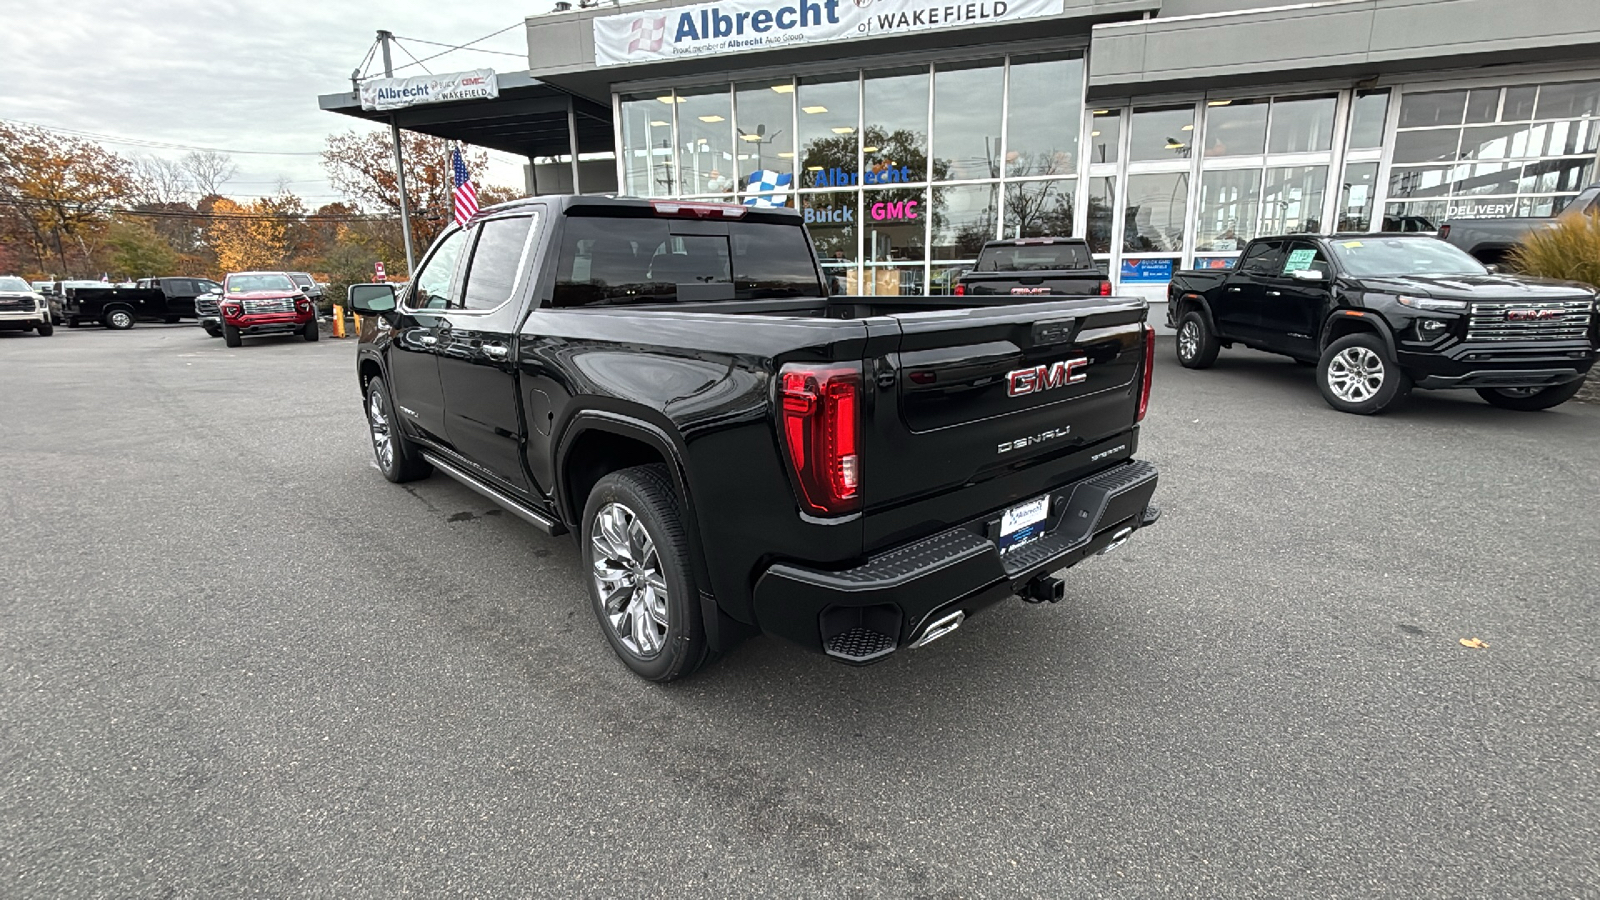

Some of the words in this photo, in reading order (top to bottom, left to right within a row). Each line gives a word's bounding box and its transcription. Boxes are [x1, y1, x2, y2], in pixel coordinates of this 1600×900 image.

[674, 0, 839, 43] Albrecht
[858, 17, 872, 32] of
[877, 1, 1007, 30] WAKEFIELD
[728, 37, 763, 48] Albrecht
[765, 35, 781, 44] Auto
[783, 33, 804, 43] Group
[378, 84, 429, 100] Albrecht
[442, 88, 487, 99] WAKEFIELD
[814, 165, 910, 187] Albrecht
[804, 205, 854, 224] Buick
[871, 201, 918, 221] GMC
[1449, 203, 1513, 216] DELIVERY
[1005, 357, 1088, 398] GMC
[997, 425, 1071, 454] DENALI
